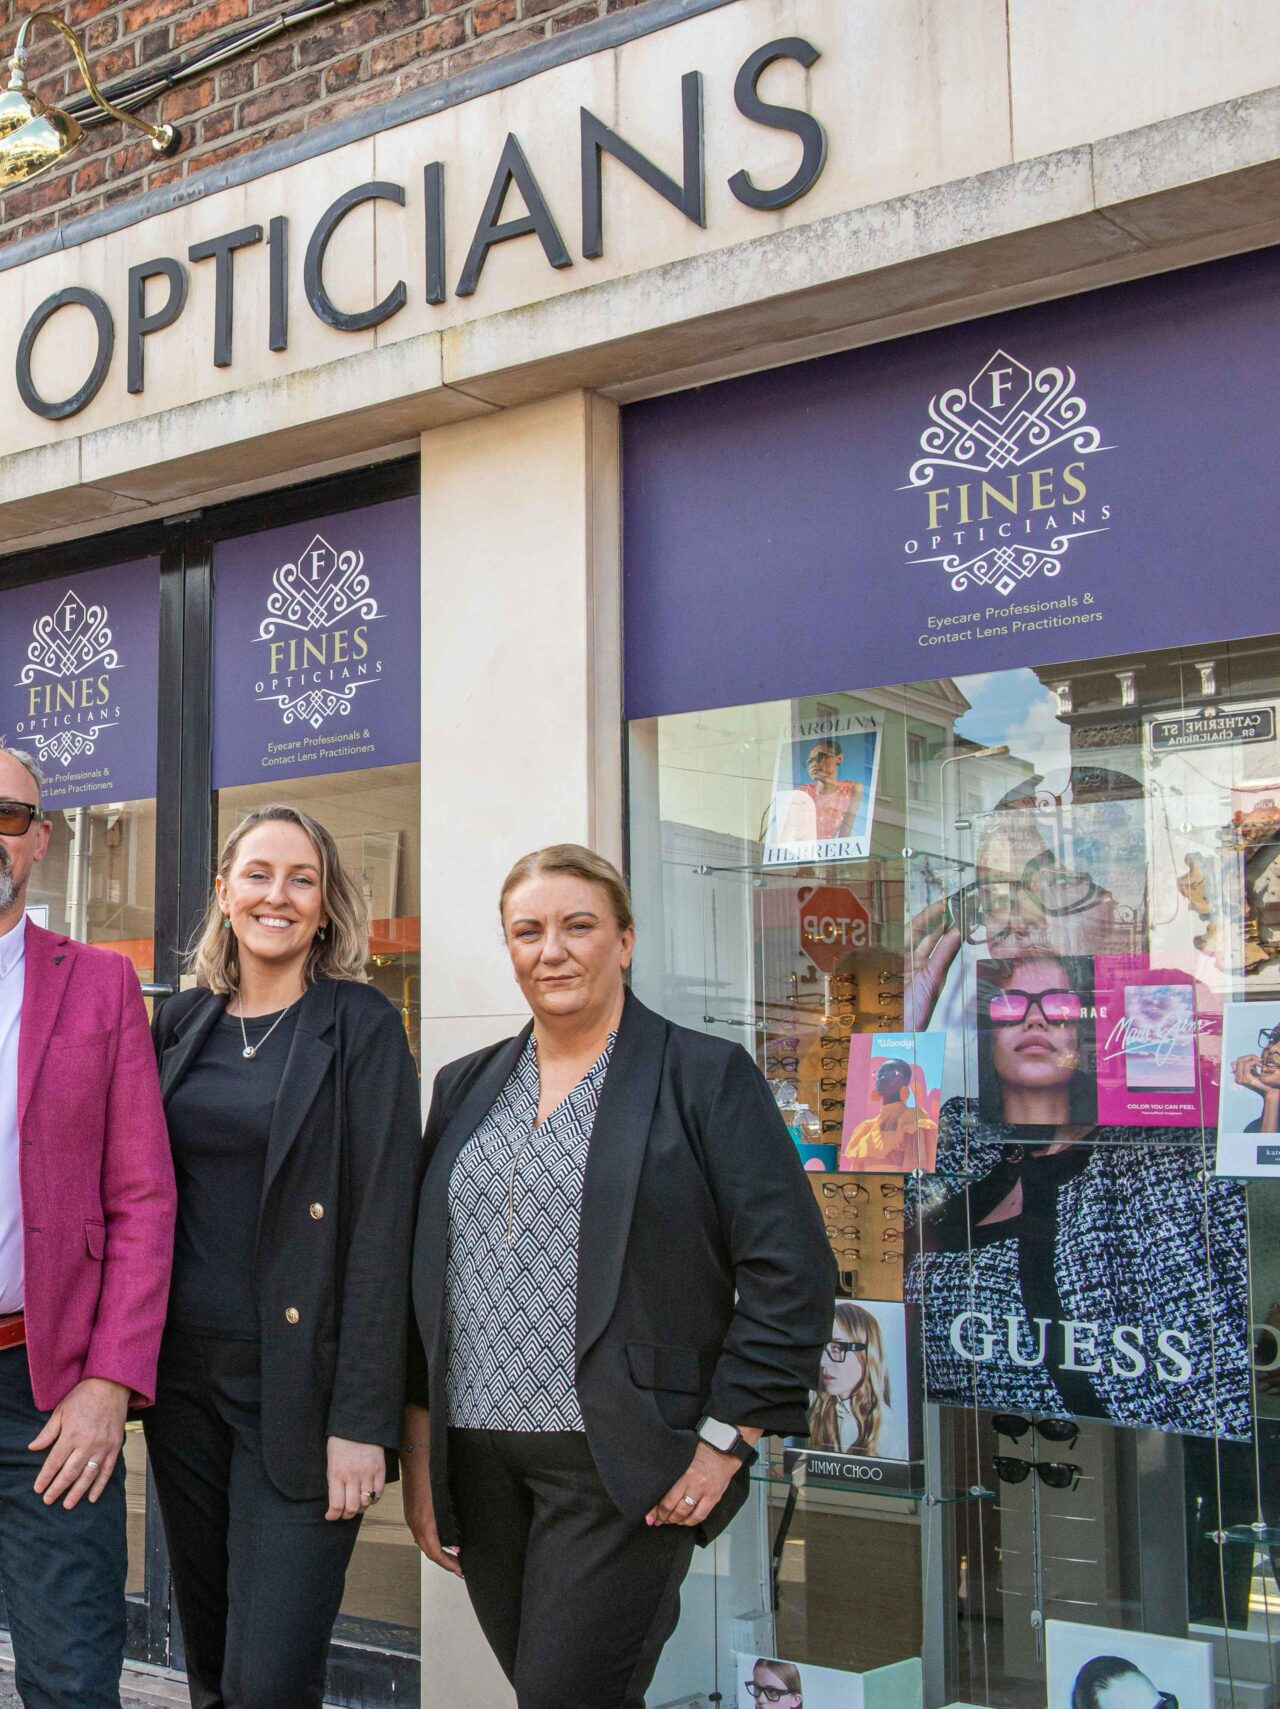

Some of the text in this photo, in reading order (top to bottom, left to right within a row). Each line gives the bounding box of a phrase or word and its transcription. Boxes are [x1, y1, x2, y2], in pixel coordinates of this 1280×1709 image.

[15, 36, 829, 421] OPTICIANS
[988, 367, 1013, 409] F
[924, 462, 1087, 531] FINES
[904, 505, 1111, 553] OPTICIANS
[310, 549, 325, 581] F
[63, 604, 77, 633] F
[927, 592, 1095, 629] Eyecare Professionals &
[918, 611, 1103, 647] Contact Lens Practitioners
[268, 625, 368, 675] FINES
[255, 660, 382, 693] OPTICIANS
[28, 674, 110, 717] FINES
[17, 706, 120, 733] OPTICIANS
[783, 715, 877, 739] CAROLINA
[261, 743, 375, 767] Contact Lens Practitioners
[267, 728, 370, 753] Eyecare Professionals &
[50, 788, 66, 796] Lens
[68, 781, 113, 793] Practitioners
[55, 769, 102, 783] Professionals
[104, 767, 110, 777] &
[767, 840, 862, 863] HERRERA
[950, 1311, 1192, 1383] GUESS
[807, 1460, 883, 1480] JIMMY CHOO
